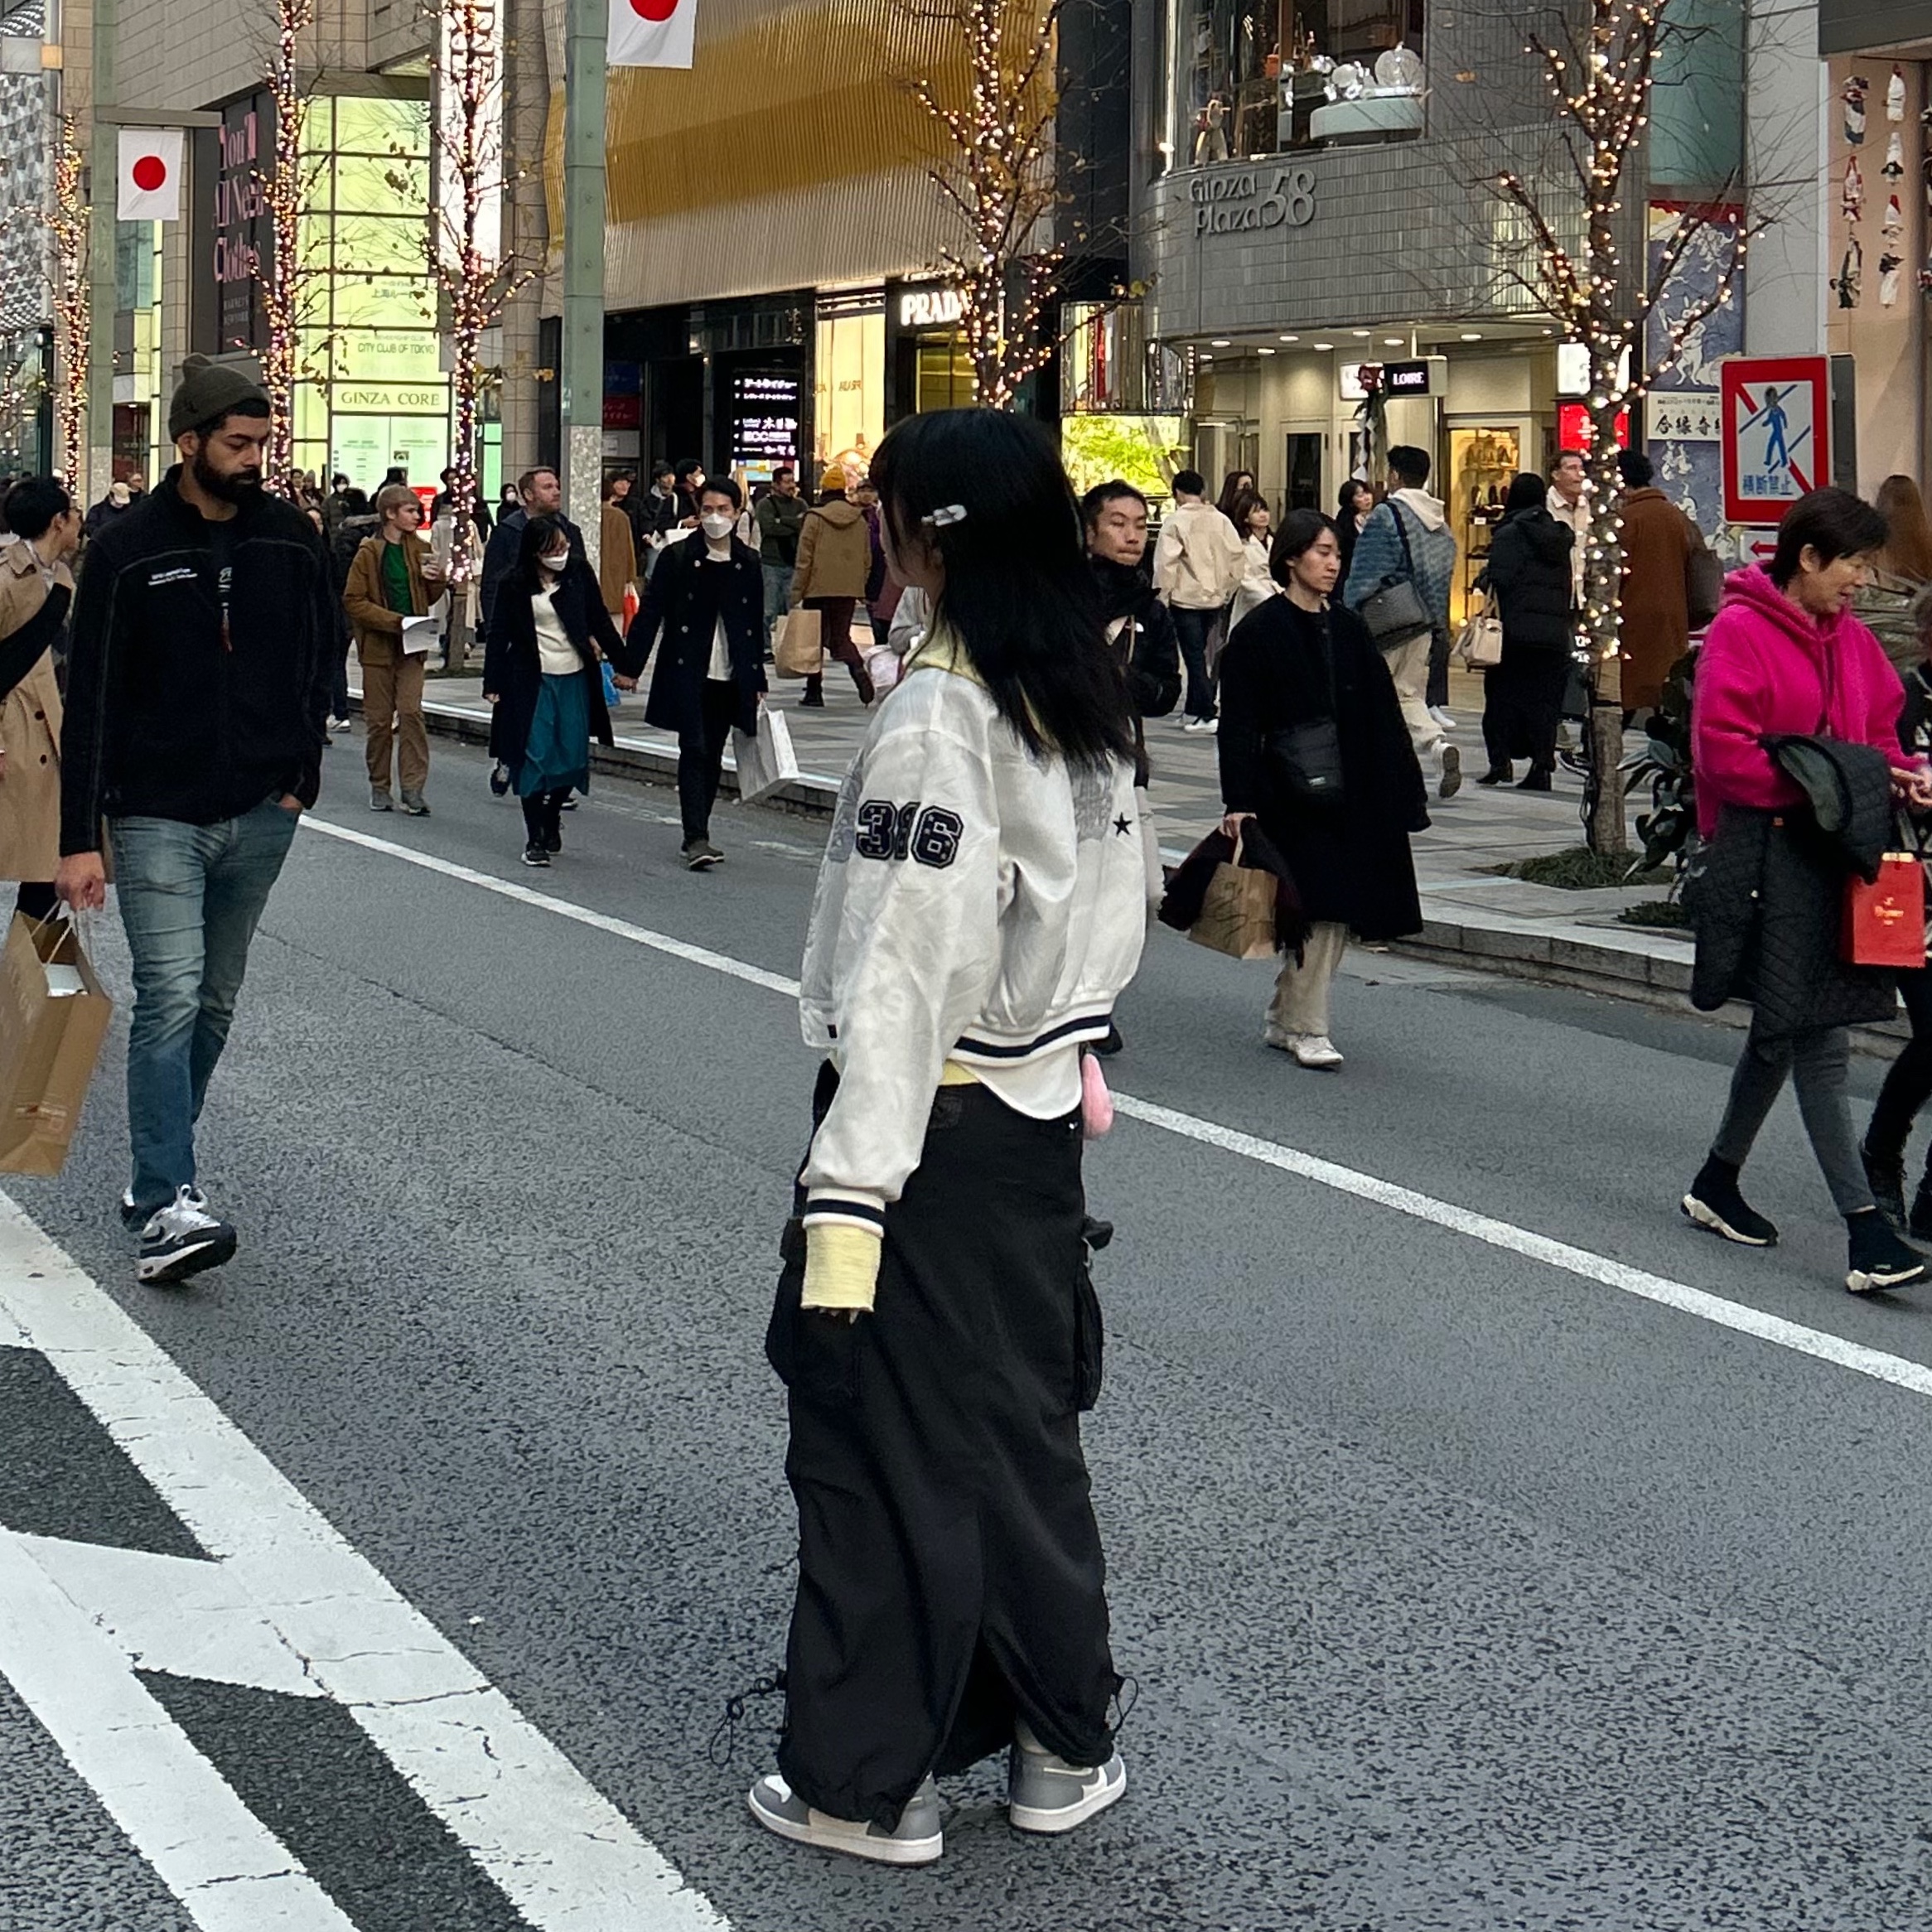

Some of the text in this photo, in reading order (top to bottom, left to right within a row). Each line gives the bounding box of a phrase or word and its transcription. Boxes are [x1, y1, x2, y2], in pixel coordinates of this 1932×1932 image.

[1190, 171, 1257, 202] Ginza
[1260, 167, 1316, 229] 58
[1195, 205, 1261, 239] Plaza
[358, 343, 374, 353] CITY
[398, 344, 408, 354] OF
[410, 344, 435, 355] TOKYO
[341, 392, 440, 406] GINZA CORE
[1742, 475, 1793, 495] 横断禁止
